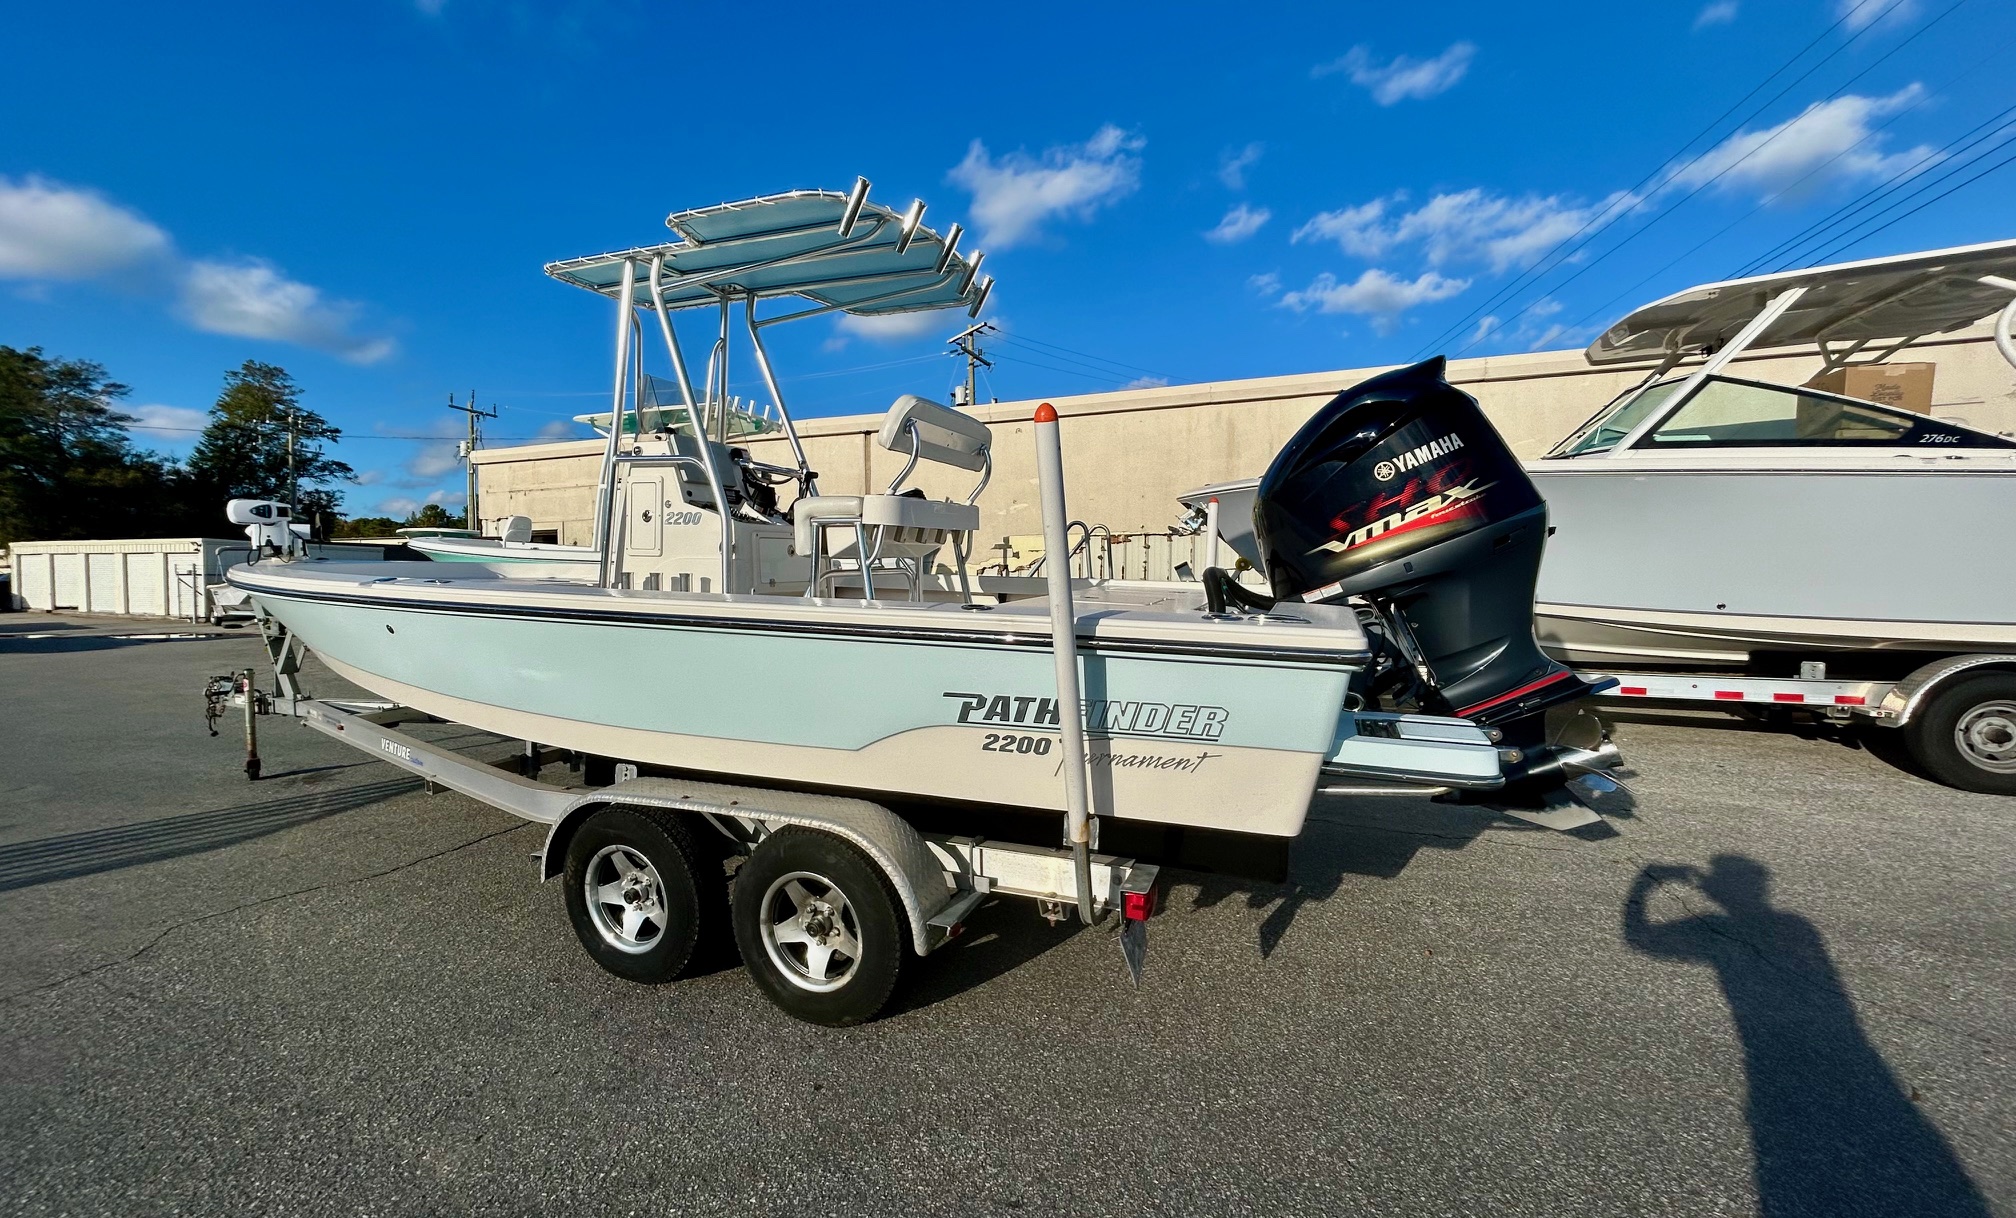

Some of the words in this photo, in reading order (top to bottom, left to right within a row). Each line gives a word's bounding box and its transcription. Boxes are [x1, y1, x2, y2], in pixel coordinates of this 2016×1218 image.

[1392, 432, 1464, 473] YAMAHA
[664, 511, 702, 525] 2200
[381, 737, 411, 760] VENTURE
[982, 733, 1052, 756] 2200
[1054, 736, 1222, 777] Turnament
